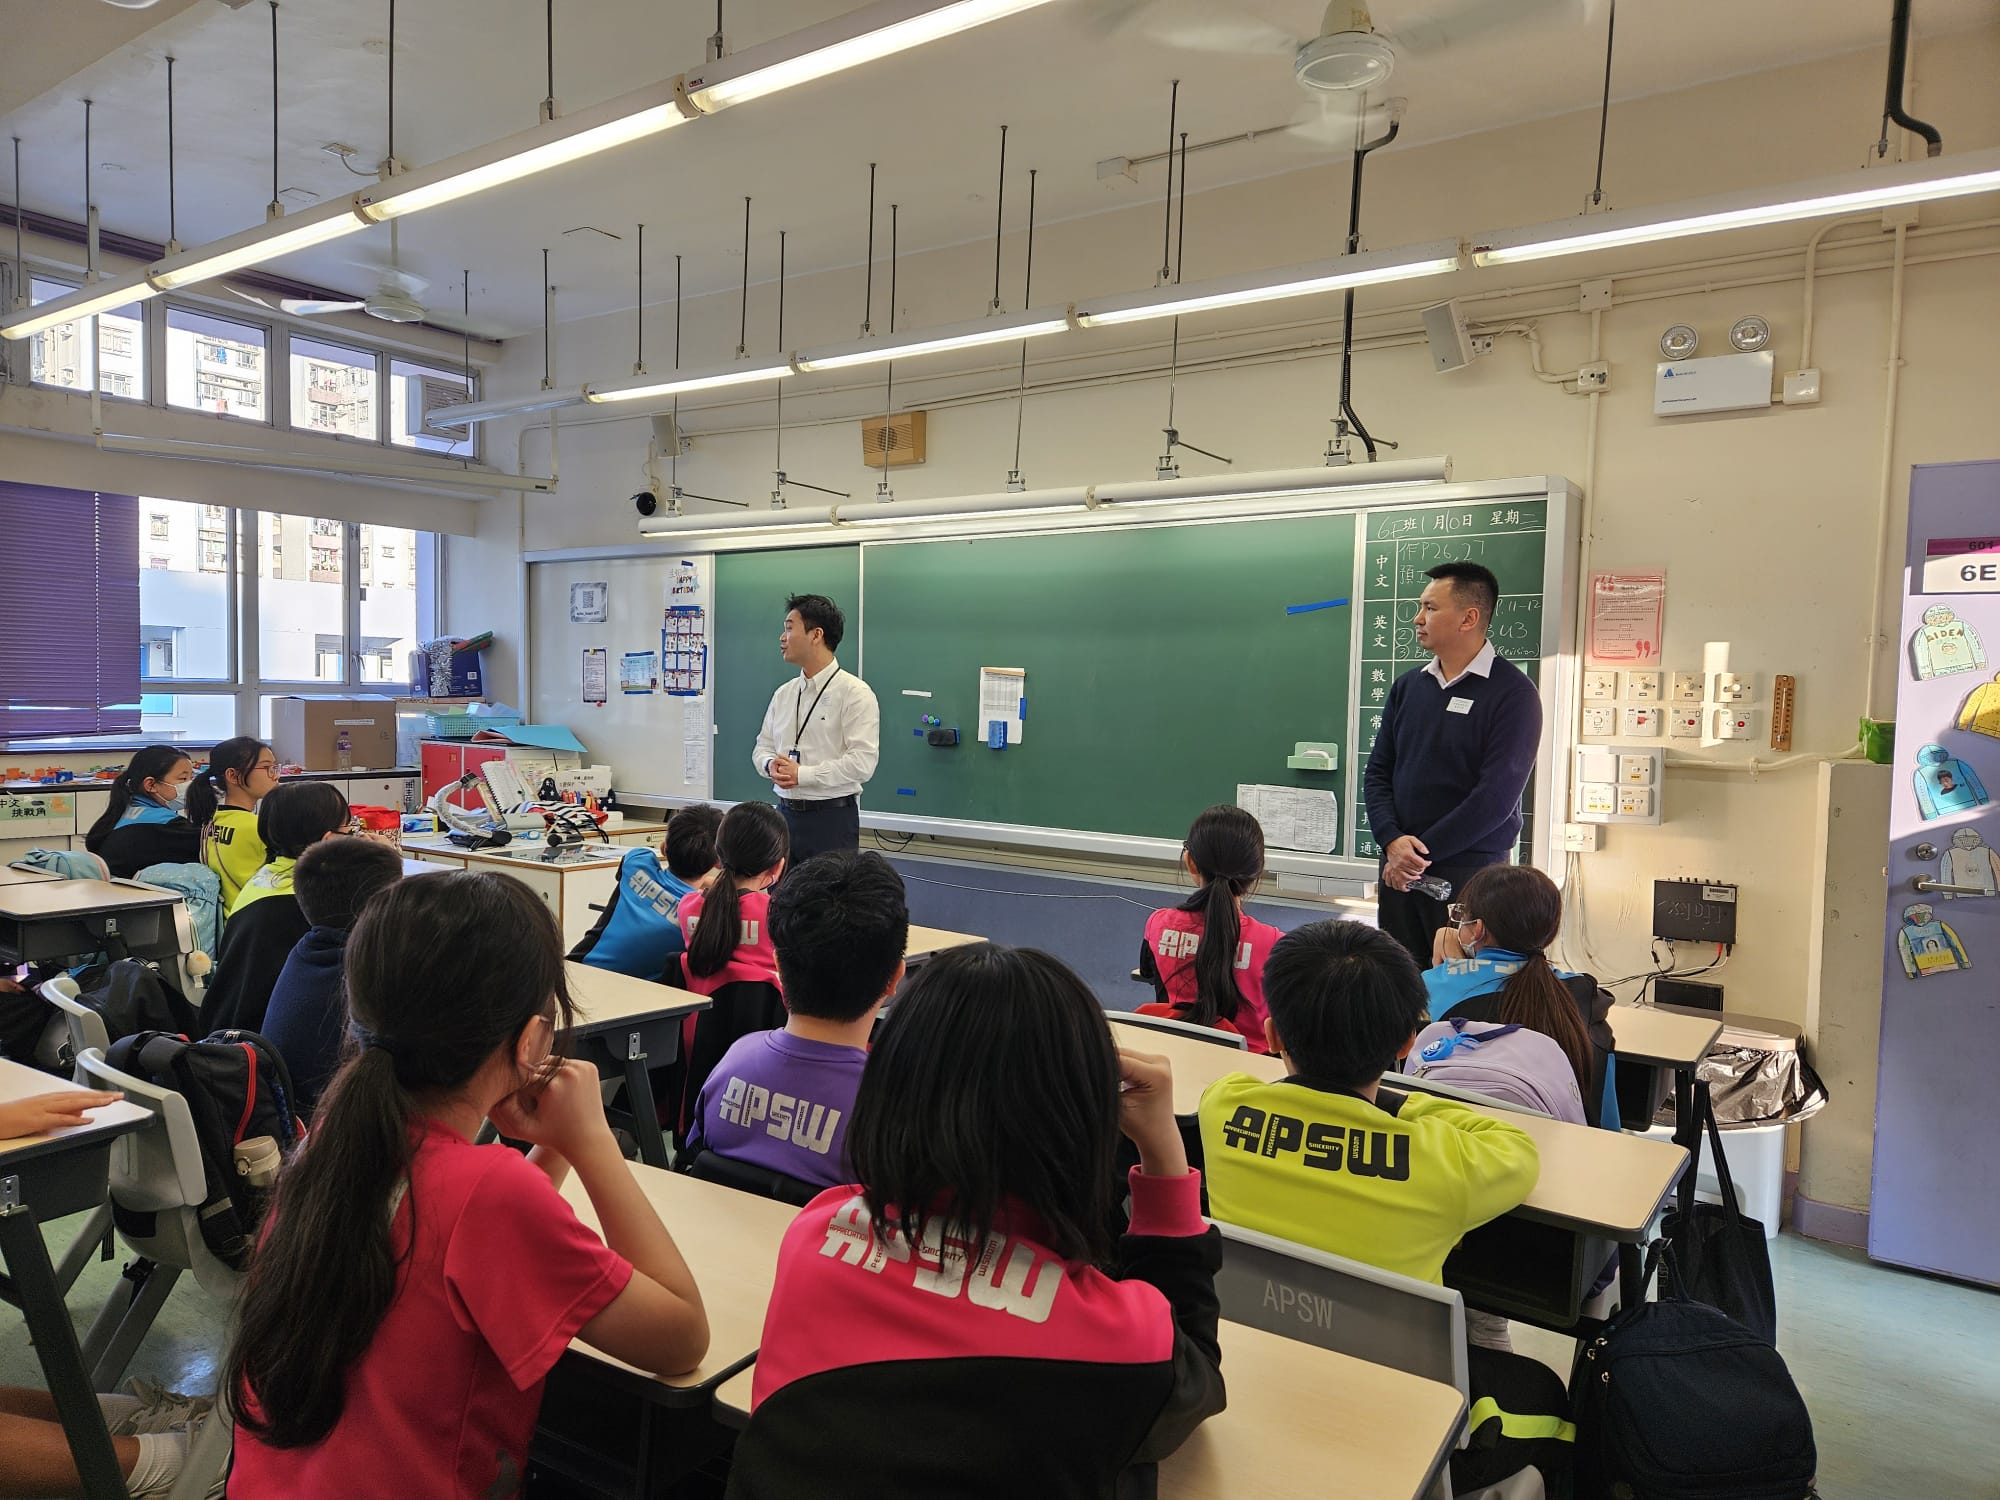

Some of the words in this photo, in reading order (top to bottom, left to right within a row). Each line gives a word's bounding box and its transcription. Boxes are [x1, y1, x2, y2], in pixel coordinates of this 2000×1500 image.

[1374, 555, 1389, 587] 中文
[1960, 564, 1997, 582] 6E
[1373, 615, 1388, 648] 英文
[1371, 669, 1387, 702] 數學
[719, 1075, 842, 1155] APSW
[1222, 1105, 1411, 1182] APSW
[979, 1239, 999, 1278] WISDOM
[1262, 1279, 1333, 1330] APSW
